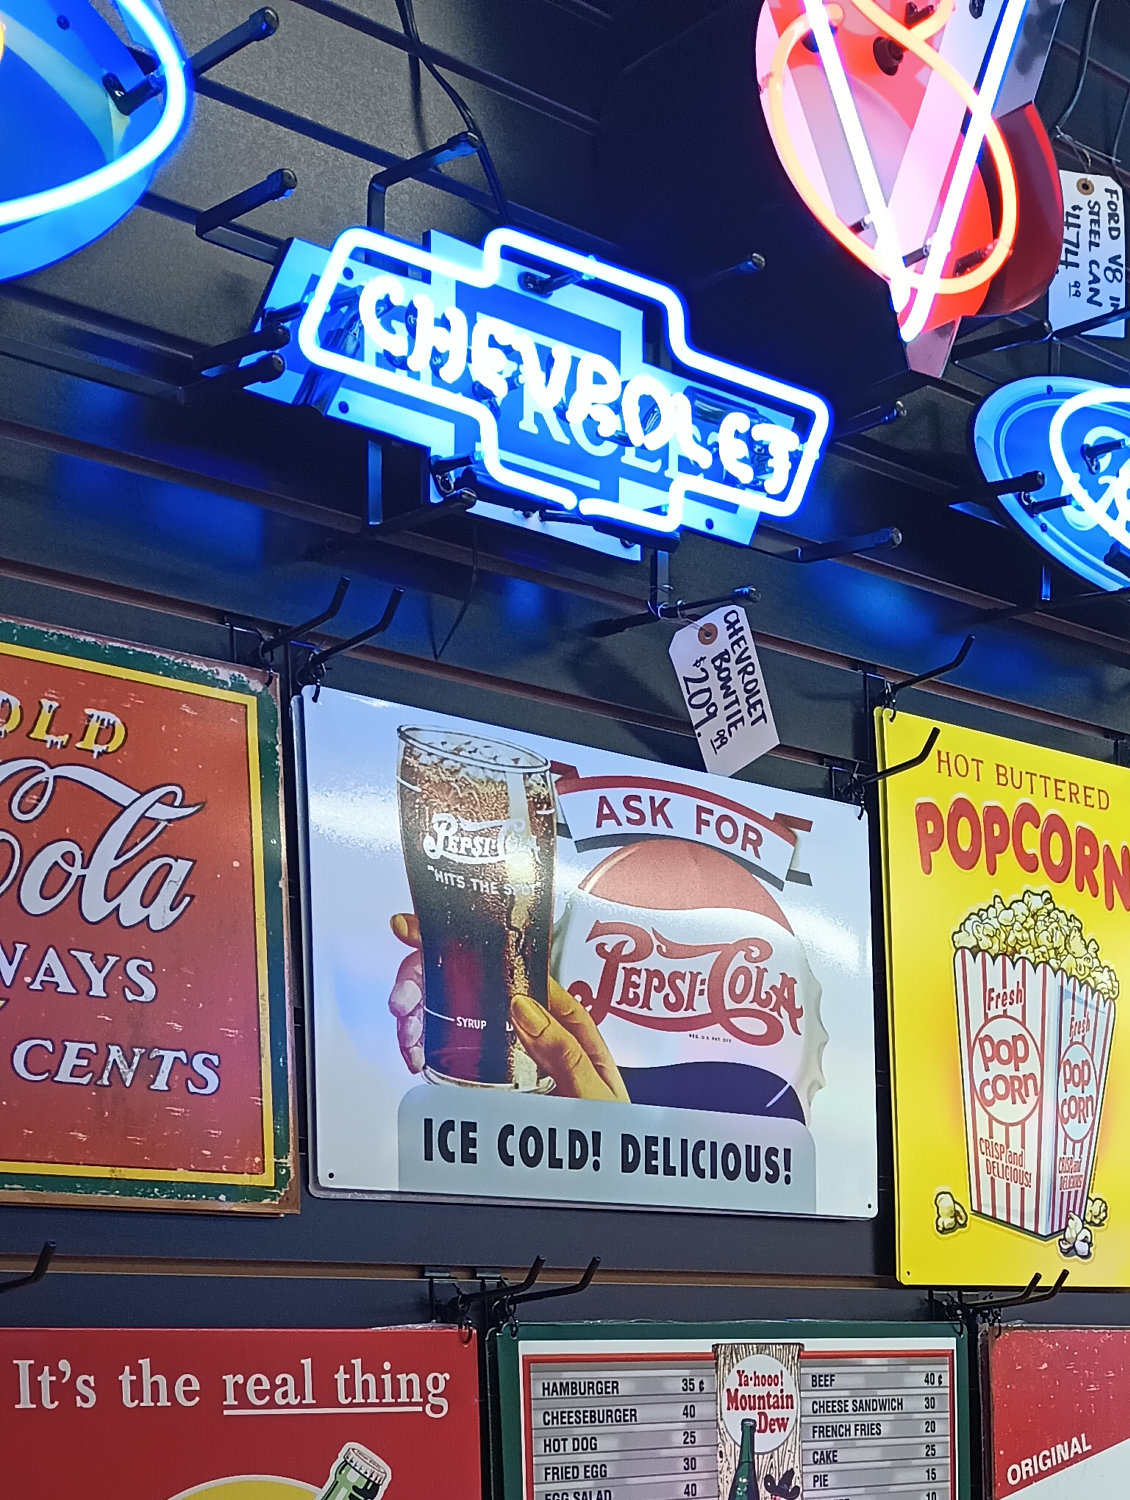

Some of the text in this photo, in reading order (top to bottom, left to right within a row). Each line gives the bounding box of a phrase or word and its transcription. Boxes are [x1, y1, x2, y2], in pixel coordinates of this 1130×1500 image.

[1086, 199, 1103, 308] STEEL CAN
[1103, 187, 1125, 284] FORD V8
[358, 275, 802, 495] CHEVROLET
[710, 648, 745, 739] BOWTIE
[723, 609, 768, 727] CHEVROLET
[935, 750, 1111, 811] HOT BUTTERED
[595, 794, 764, 860] ASK FOR
[456, 1015, 487, 1030] SYRUP
[987, 981, 1024, 1012] Fresh
[11, 1037, 221, 1096] CENTS
[422, 1117, 793, 1187] ICE COLD! DELICIOUS!
[985, 1157, 1032, 1189] DELICIOUS!
[12, 1357, 451, 1419] It's the real thing
[542, 1377, 696, 1397] HAMBURGER 35
[726, 1387, 795, 1412] Mountain
[811, 1374, 836, 1388] BEEF
[542, 1408, 638, 1426] CHEESEBURGER
[756, 1411, 790, 1434] Dew
[812, 1422, 882, 1440] FRENCH FRIES
[1006, 1432, 1092, 1487] ORIGINAL
